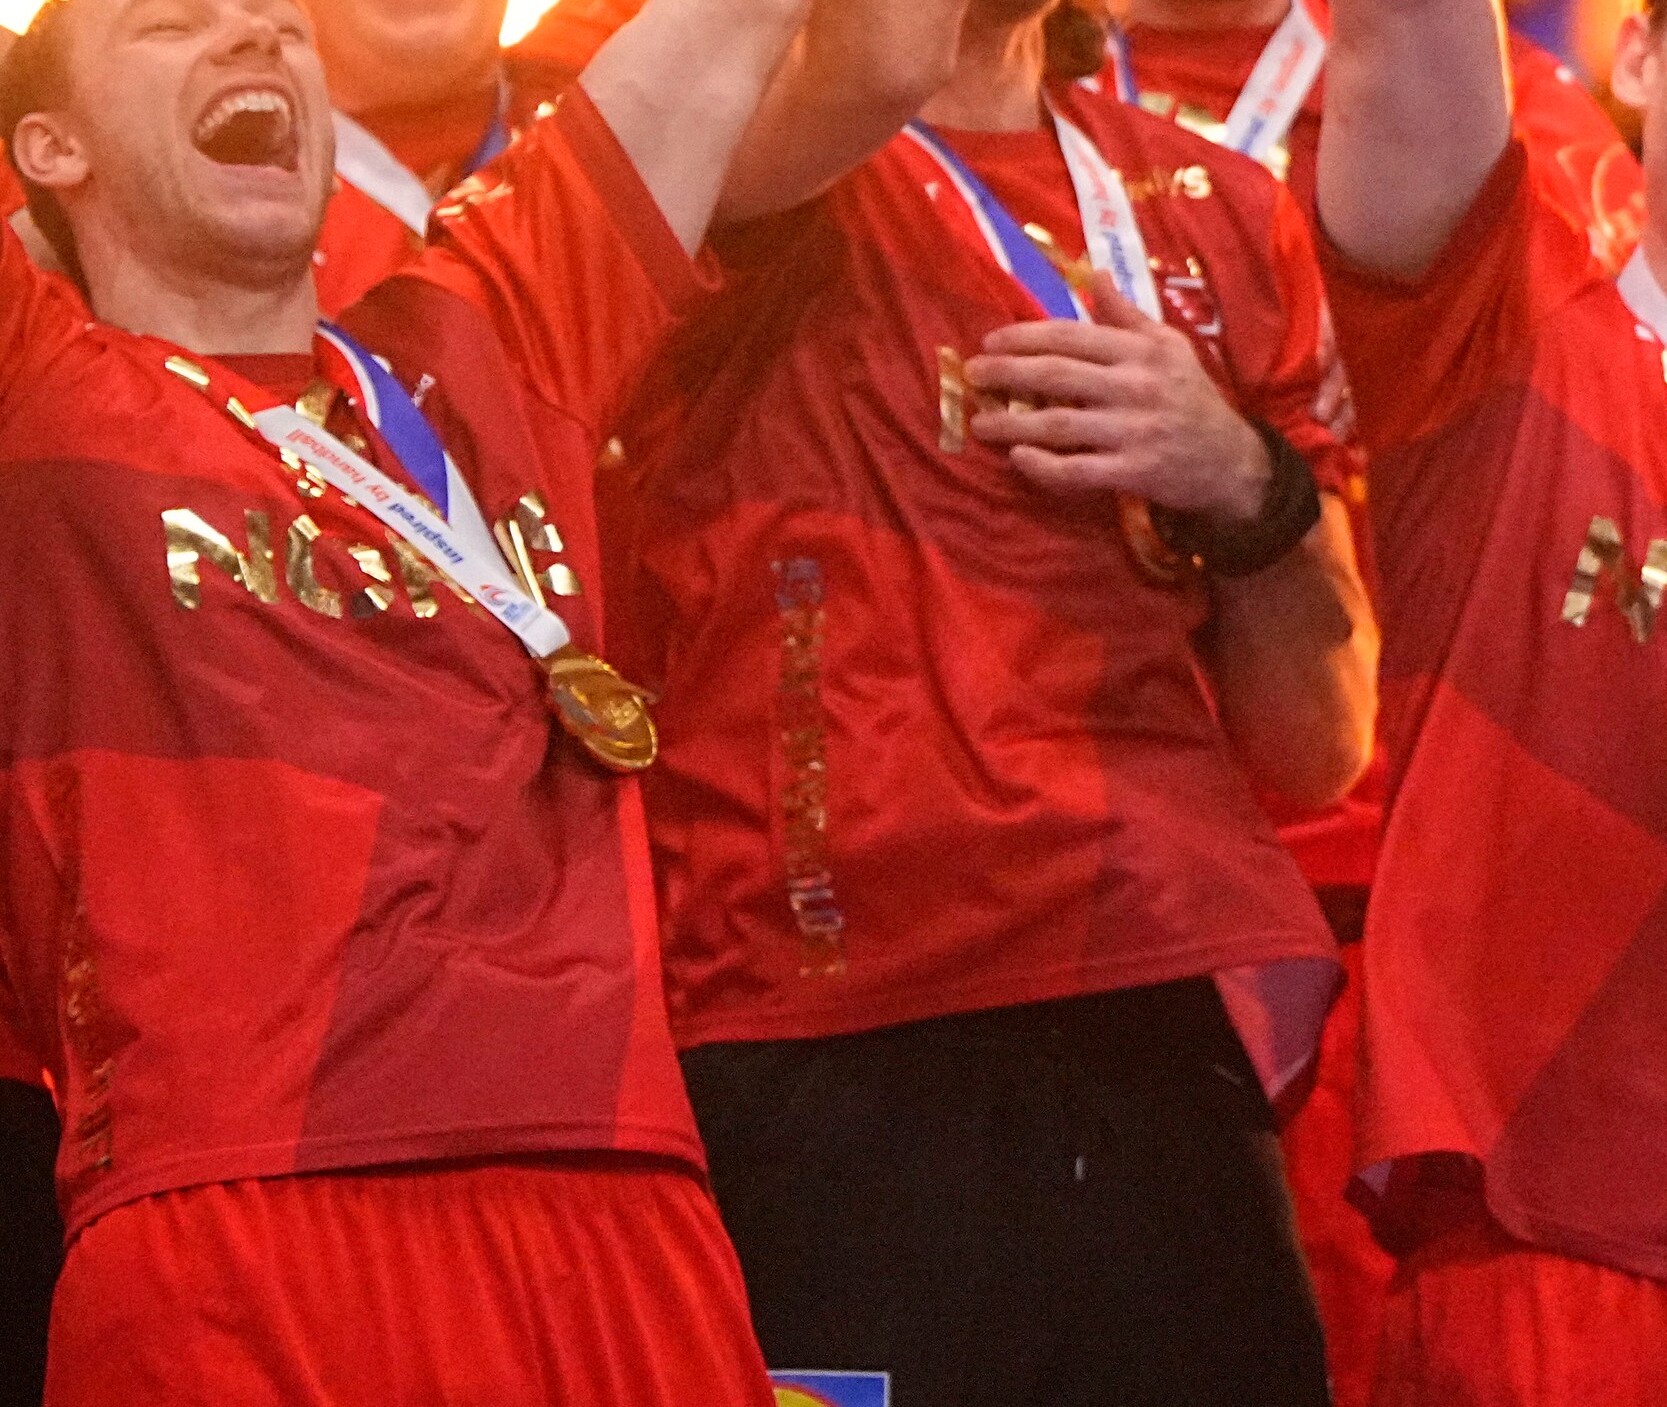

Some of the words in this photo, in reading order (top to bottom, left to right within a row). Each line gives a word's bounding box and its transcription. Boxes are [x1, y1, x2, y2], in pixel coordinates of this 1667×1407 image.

[286, 428, 364, 484] handball
[366, 483, 390, 503] by
[388, 502, 464, 564] inspired
